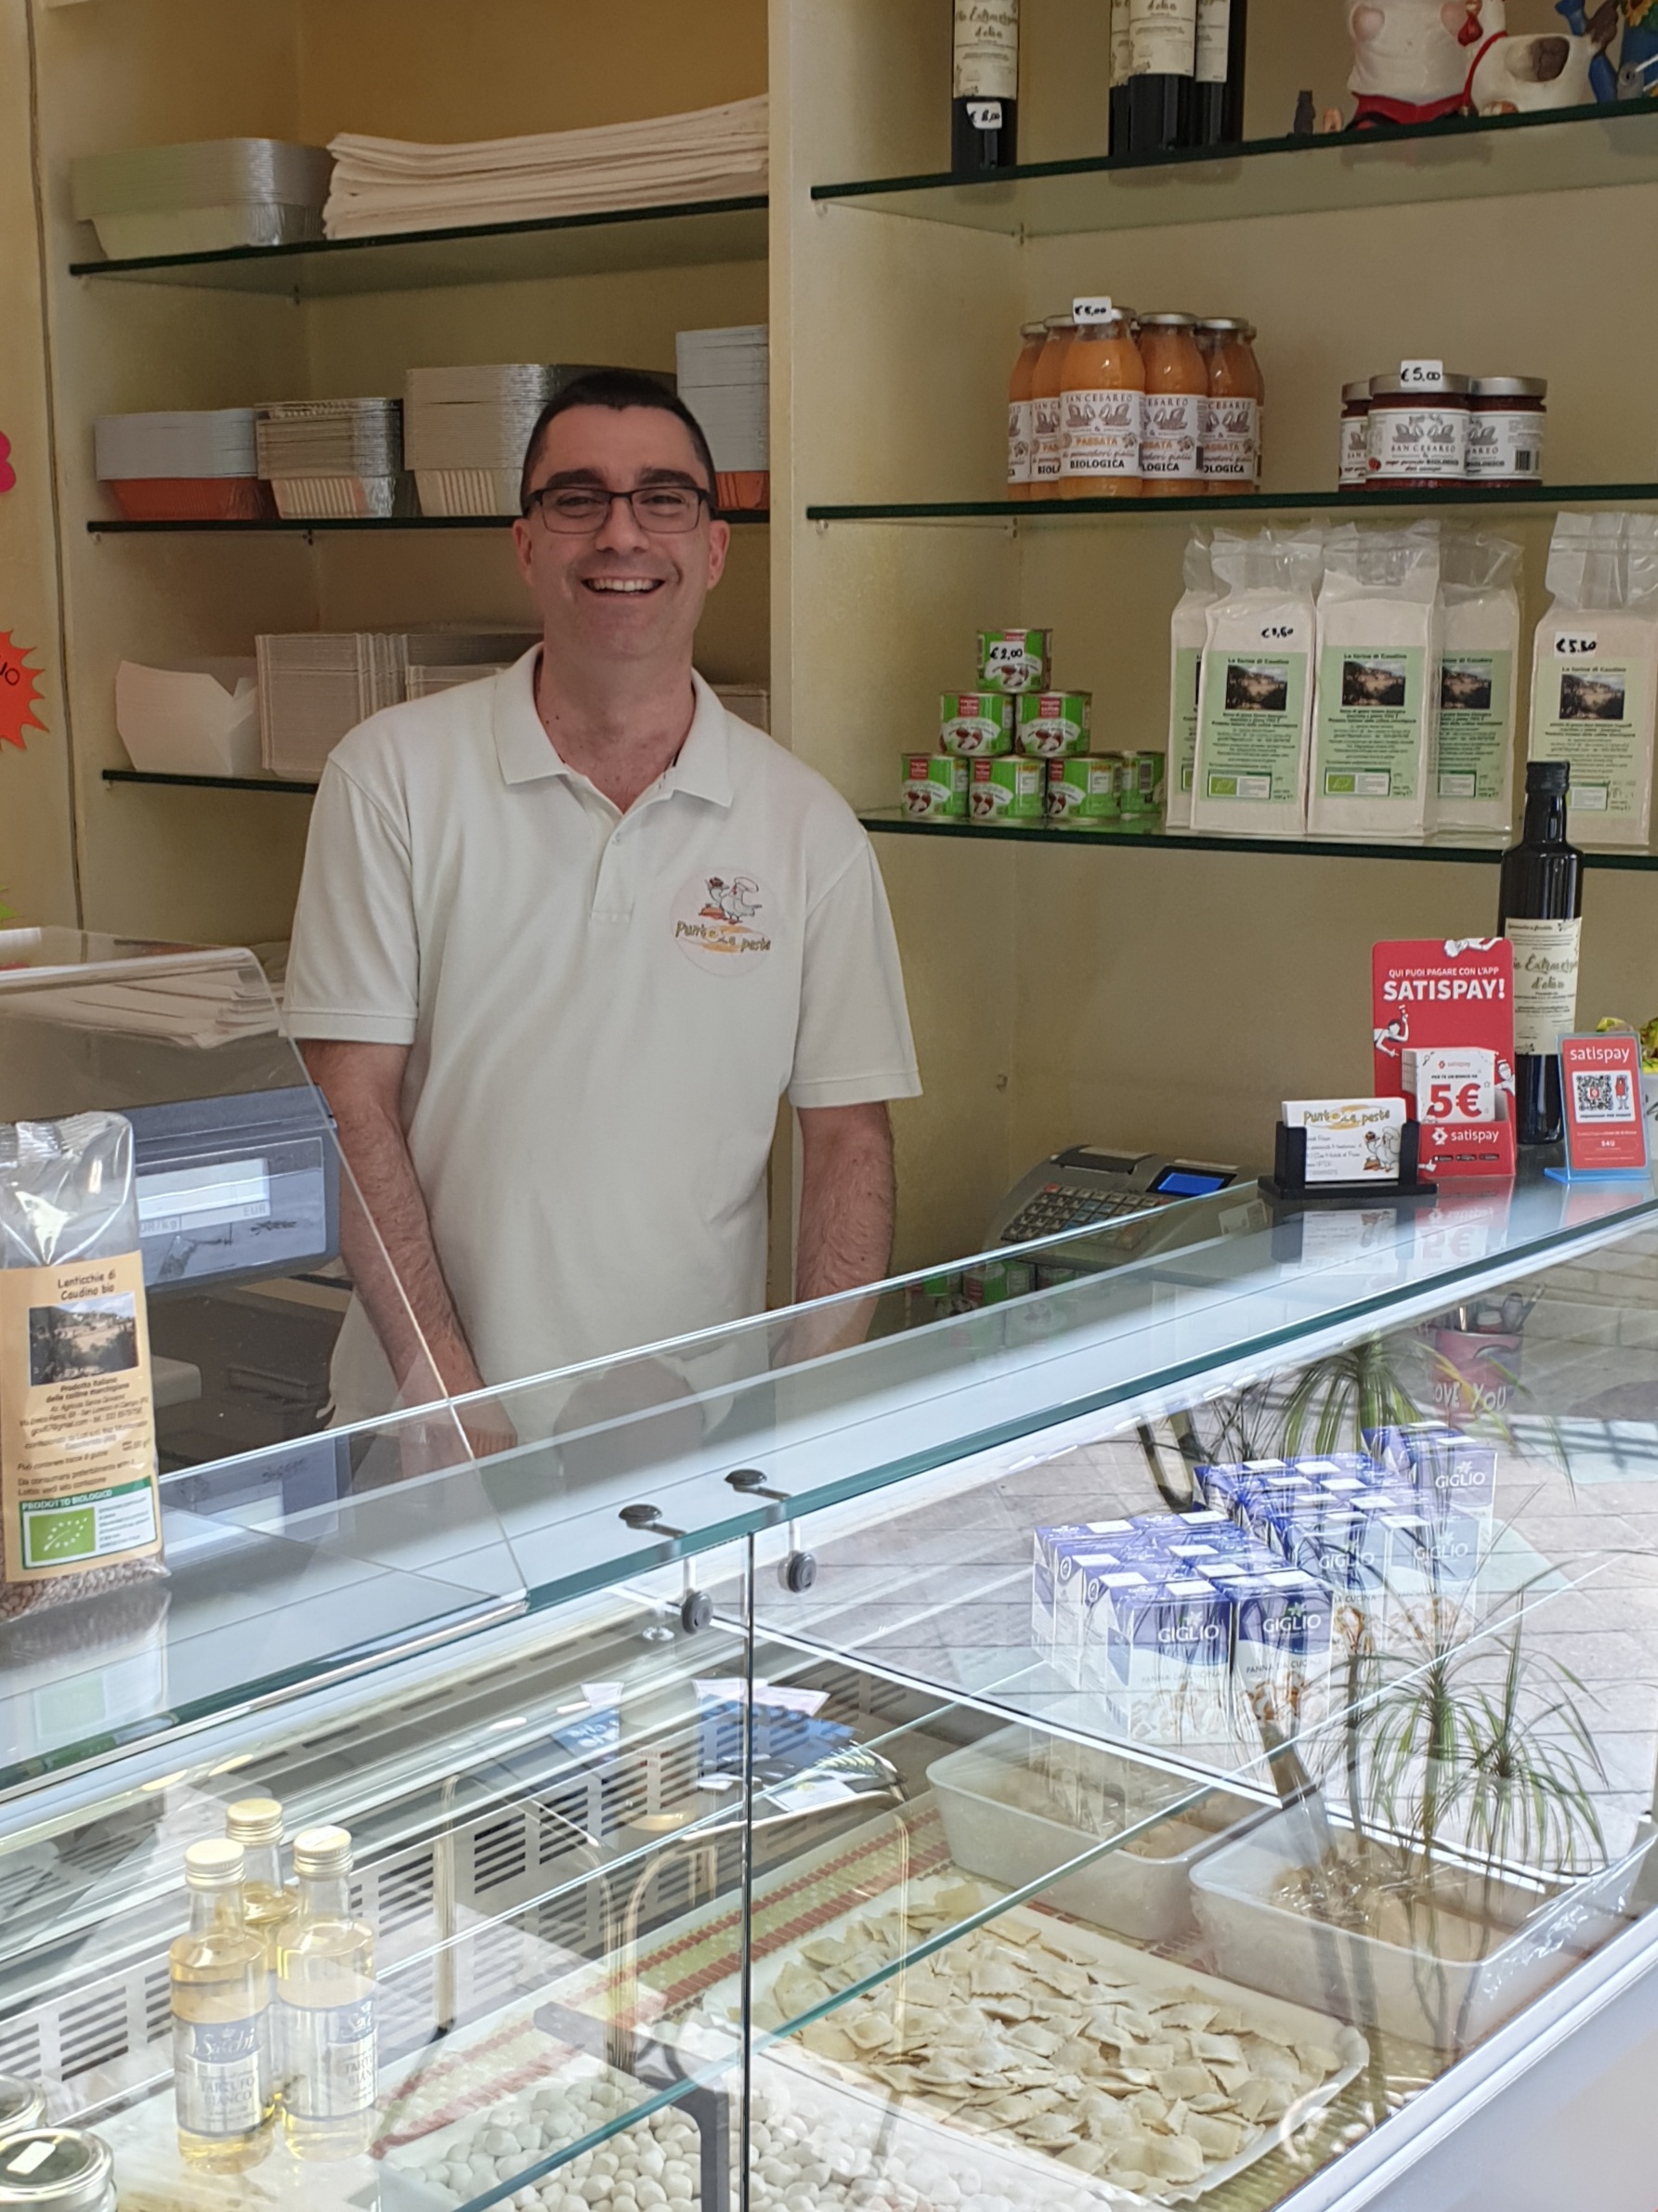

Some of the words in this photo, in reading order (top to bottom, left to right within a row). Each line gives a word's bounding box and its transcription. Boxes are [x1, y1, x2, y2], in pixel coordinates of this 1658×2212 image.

[1147, 397, 1189, 407] ESAREO
[1069, 459, 1126, 470] BIOLOGICA
[1142, 462, 1181, 473] LOGICA
[1203, 464, 1245, 474] OLOGICA
[1389, 969, 1404, 979] QUI
[1404, 968, 1426, 978] PUOI
[1427, 967, 1457, 977] PAGARE
[1458, 967, 1476, 976] CON
[1477, 966, 1499, 975] L'APP
[1382, 978, 1506, 1002] SATISPAY!
[1570, 1046, 1630, 1064] satispay
[1451, 1129, 1500, 1144] satispay
[140, 1216, 178, 1234] UR/kg
[58, 1272, 104, 1289] Lenticchie
[108, 1269, 116, 1281] di
[101, 1282, 114, 1295] bio
[1434, 1471, 1485, 1490] GIGLIO
[21, 1496, 72, 1511] PRODOTTO
[72, 1489, 113, 1505] BIOLOGICO
[1318, 1551, 1376, 1570] GIGLIO
[1413, 1542, 1469, 1562] GIGLIO
[1262, 1613, 1322, 1634] GIGLIO
[1157, 1623, 1221, 1644] GIGLIO
